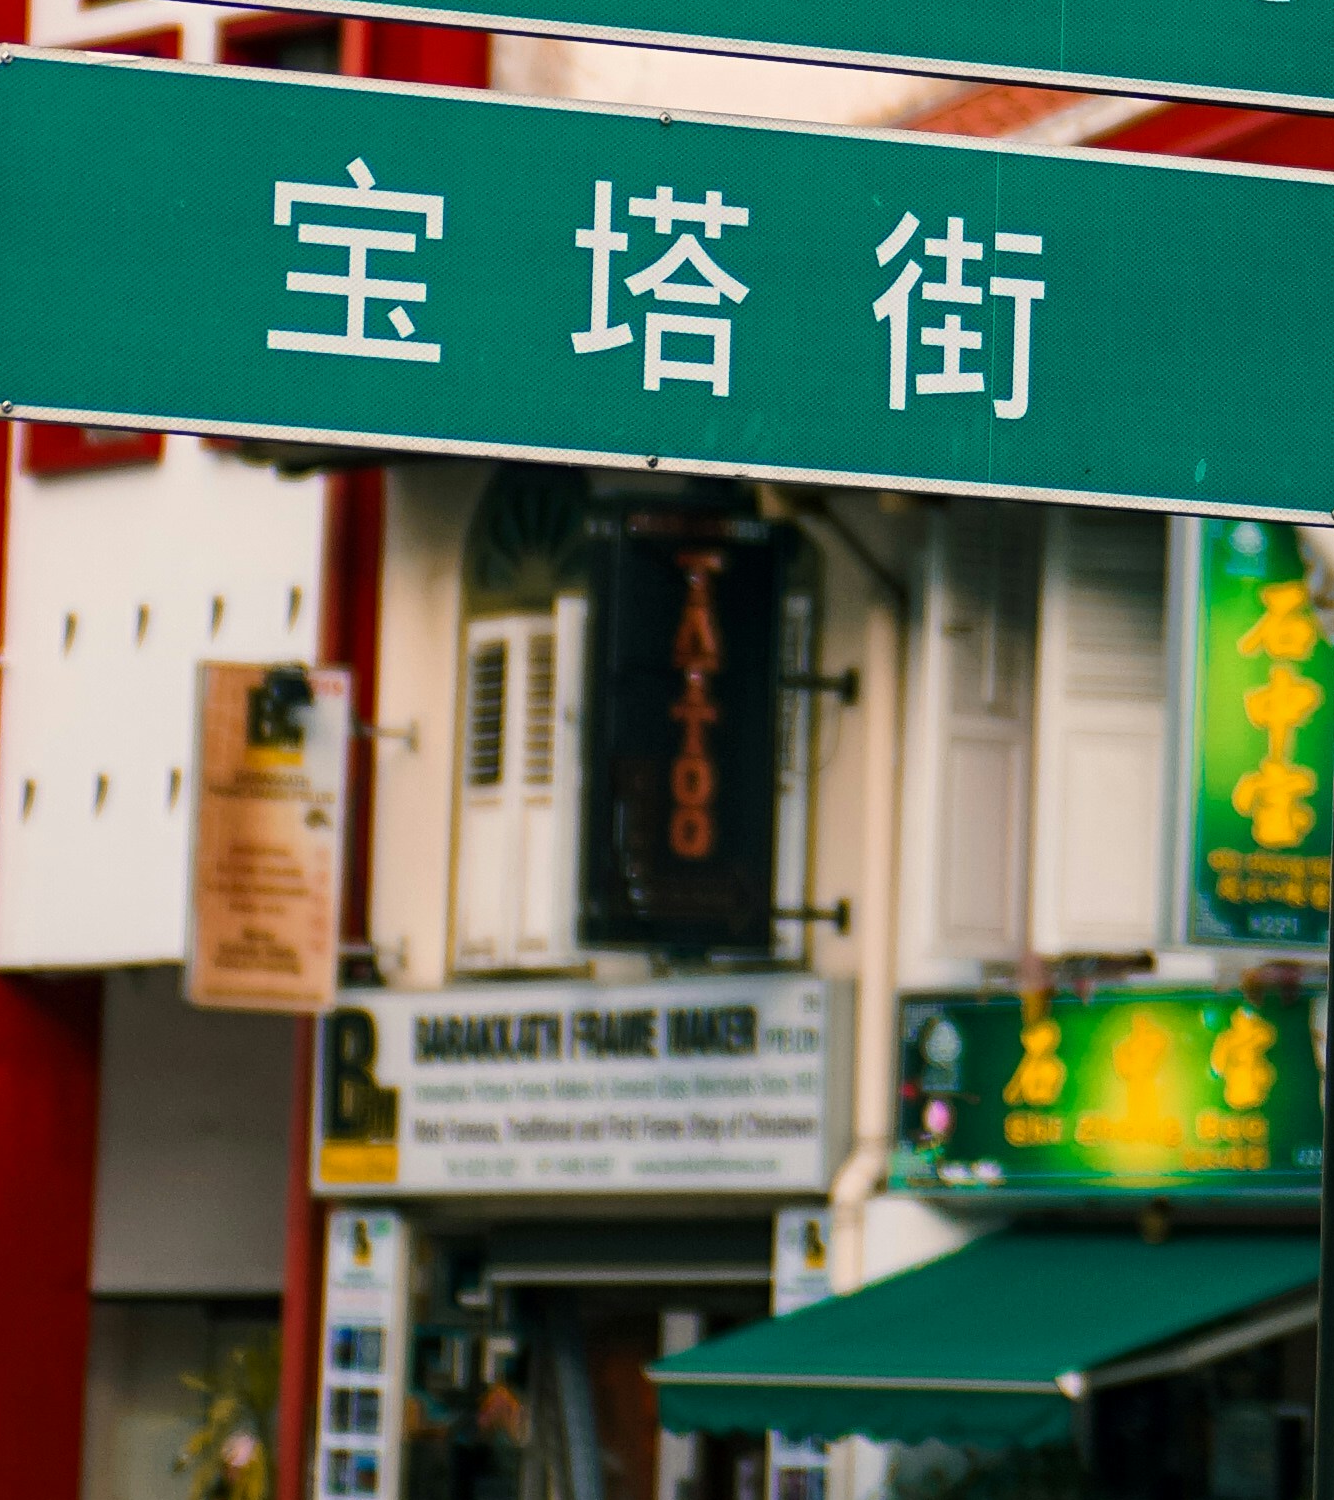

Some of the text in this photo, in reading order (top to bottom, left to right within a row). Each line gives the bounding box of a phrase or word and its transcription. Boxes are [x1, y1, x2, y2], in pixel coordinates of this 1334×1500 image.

[266, 157, 1047, 421] 宝塔街
[572, 1007, 660, 1059] FRAME
